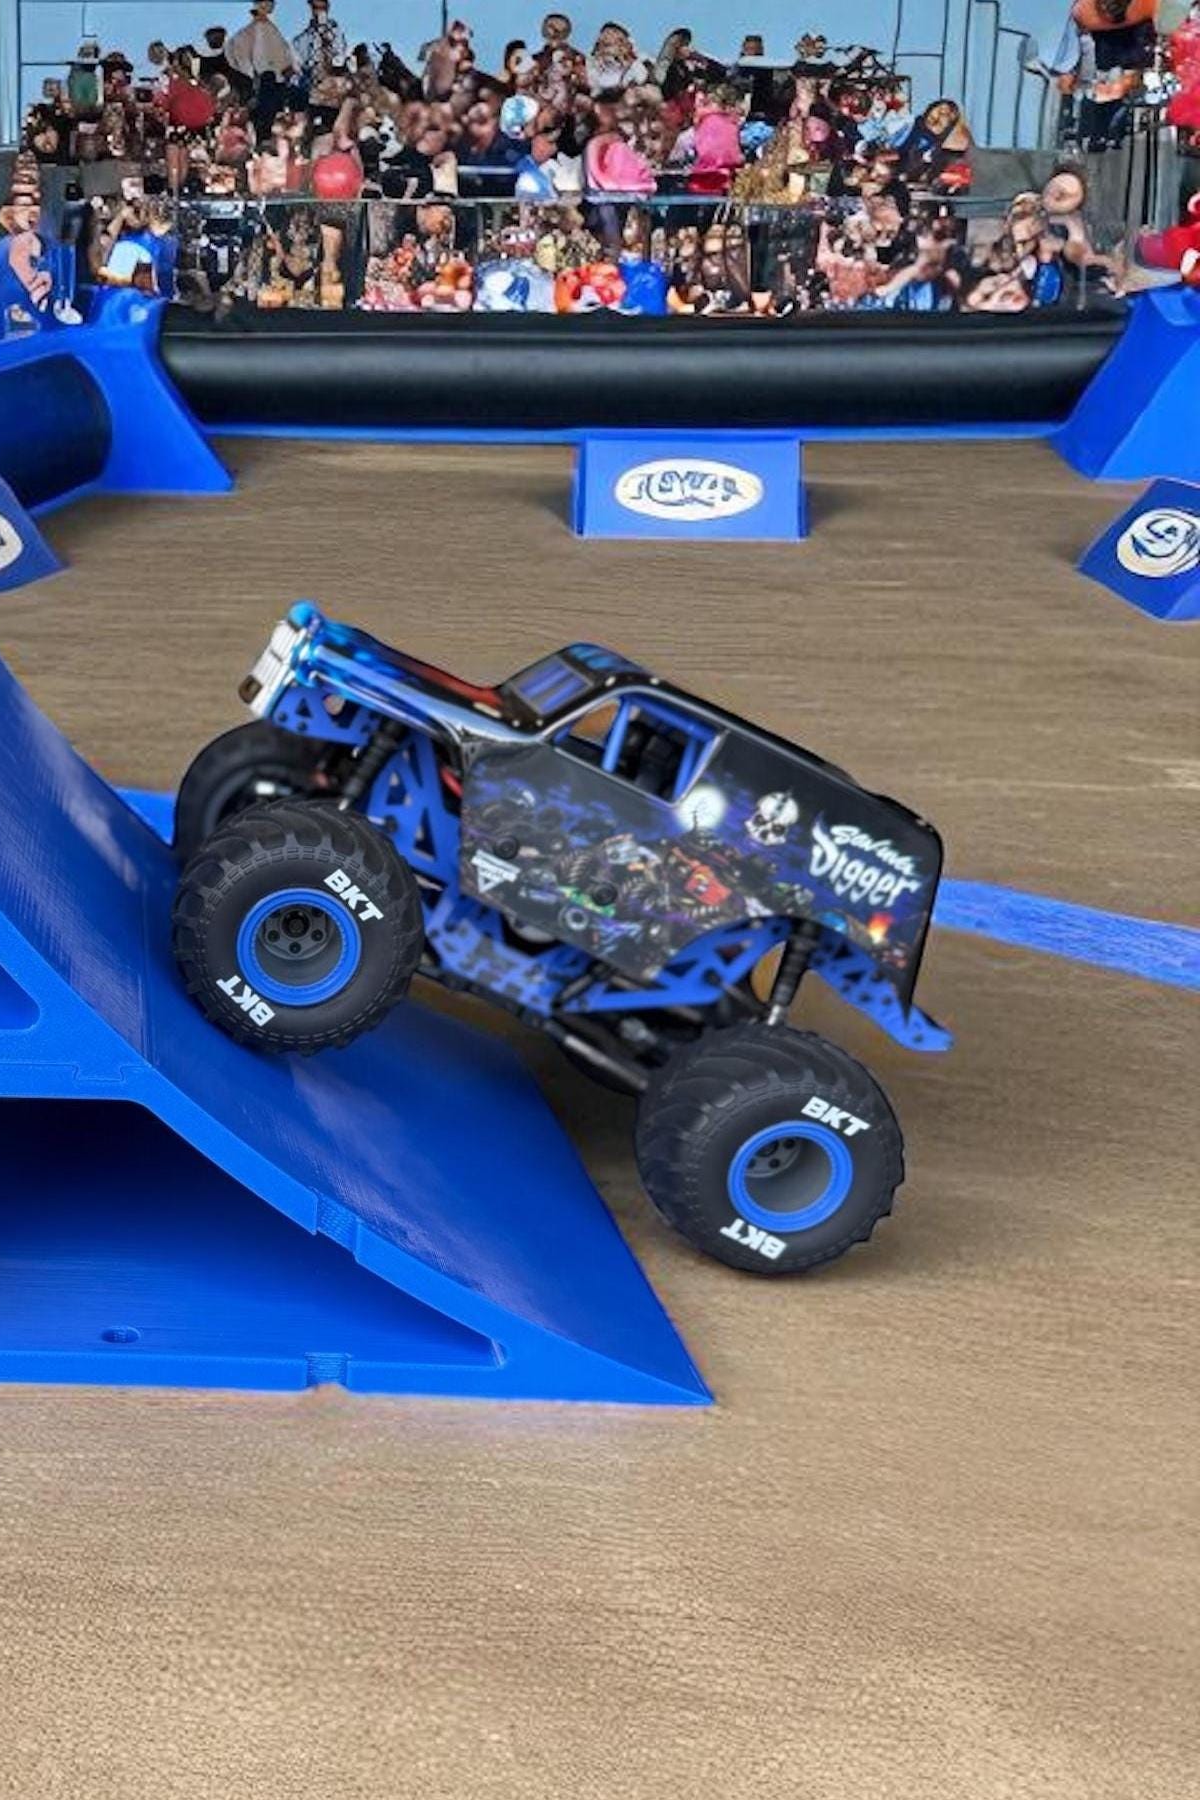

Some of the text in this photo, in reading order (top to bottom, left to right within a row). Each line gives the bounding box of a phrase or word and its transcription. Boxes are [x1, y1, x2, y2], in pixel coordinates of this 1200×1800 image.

[809, 812, 922, 908] Digger
[323, 868, 384, 921] BKT
[216, 975, 276, 1027] BKT
[800, 1095, 871, 1137] BKT
[719, 1218, 787, 1260] BKT
